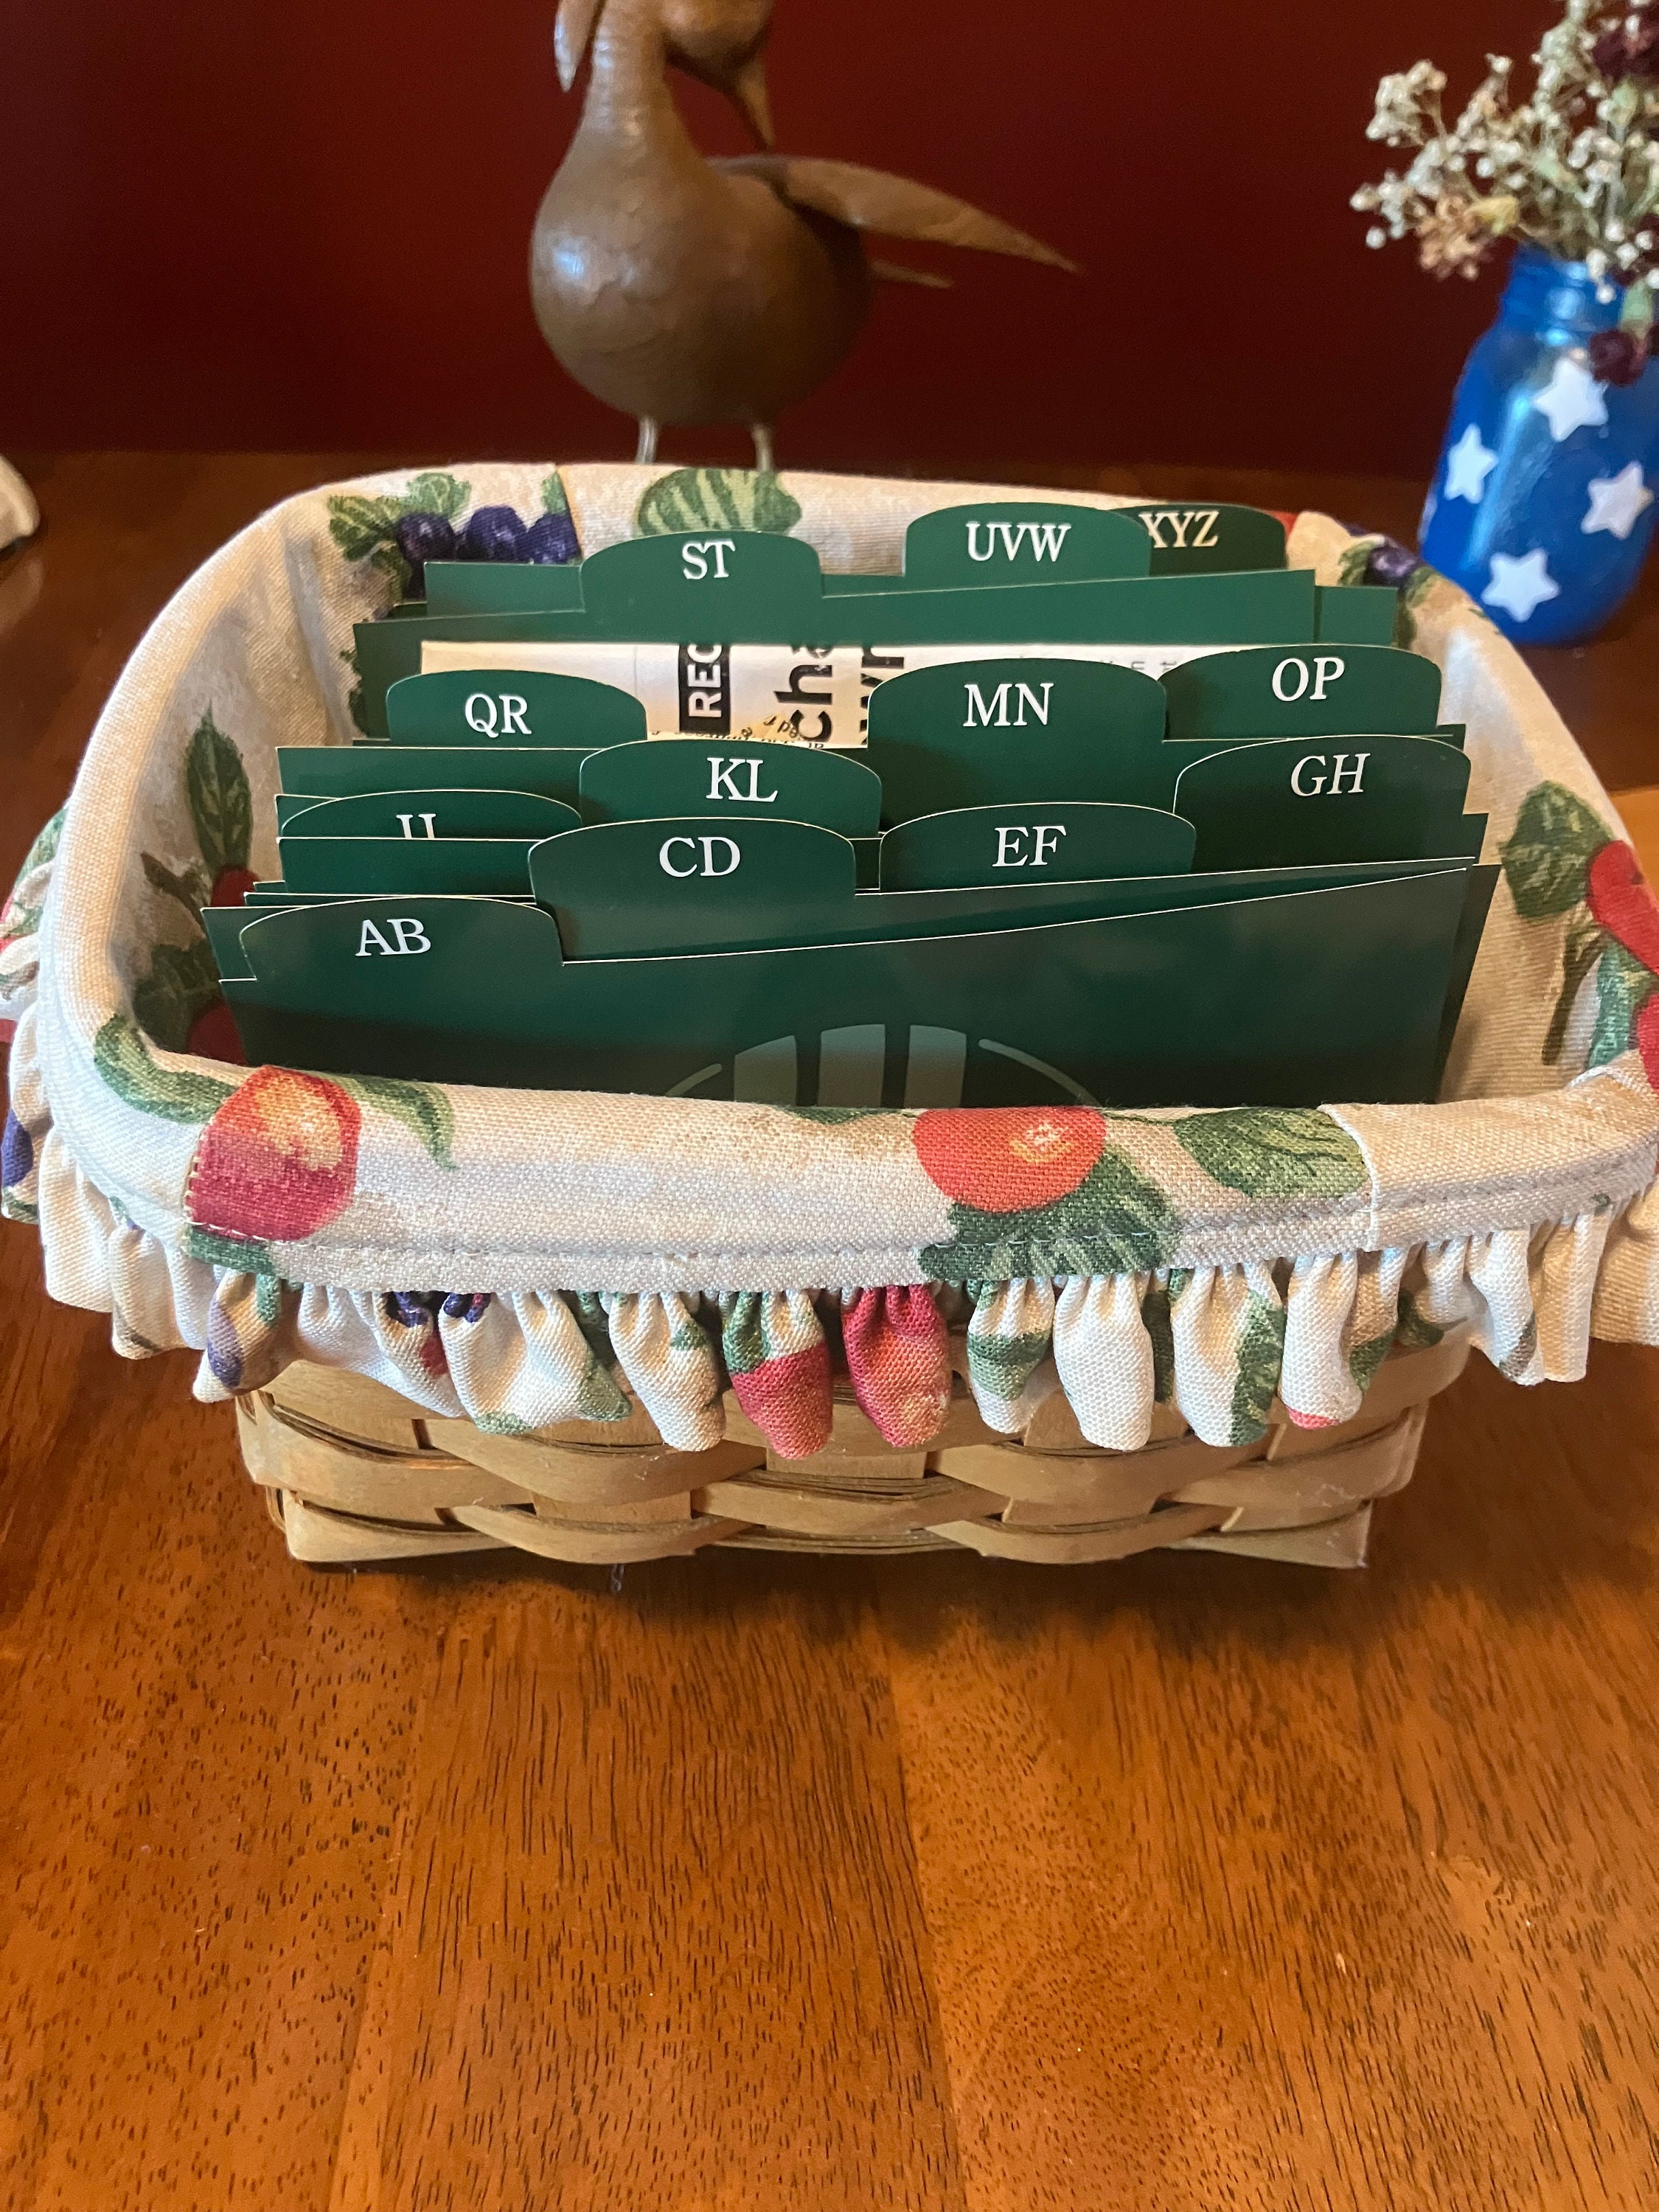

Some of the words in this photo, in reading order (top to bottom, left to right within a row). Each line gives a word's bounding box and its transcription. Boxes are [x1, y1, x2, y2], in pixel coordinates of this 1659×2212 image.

[965, 521, 1072, 563] UVW
[1138, 509, 1220, 548] XYZ
[681, 539, 737, 580] ST
[1271, 656, 1345, 702] OP
[464, 693, 532, 738] QR
[961, 682, 1055, 727] MN
[705, 757, 779, 802] KL
[1290, 753, 1371, 796] GH
[658, 836, 741, 878] CD
[991, 825, 1067, 867] EF
[354, 918, 431, 957] AB
